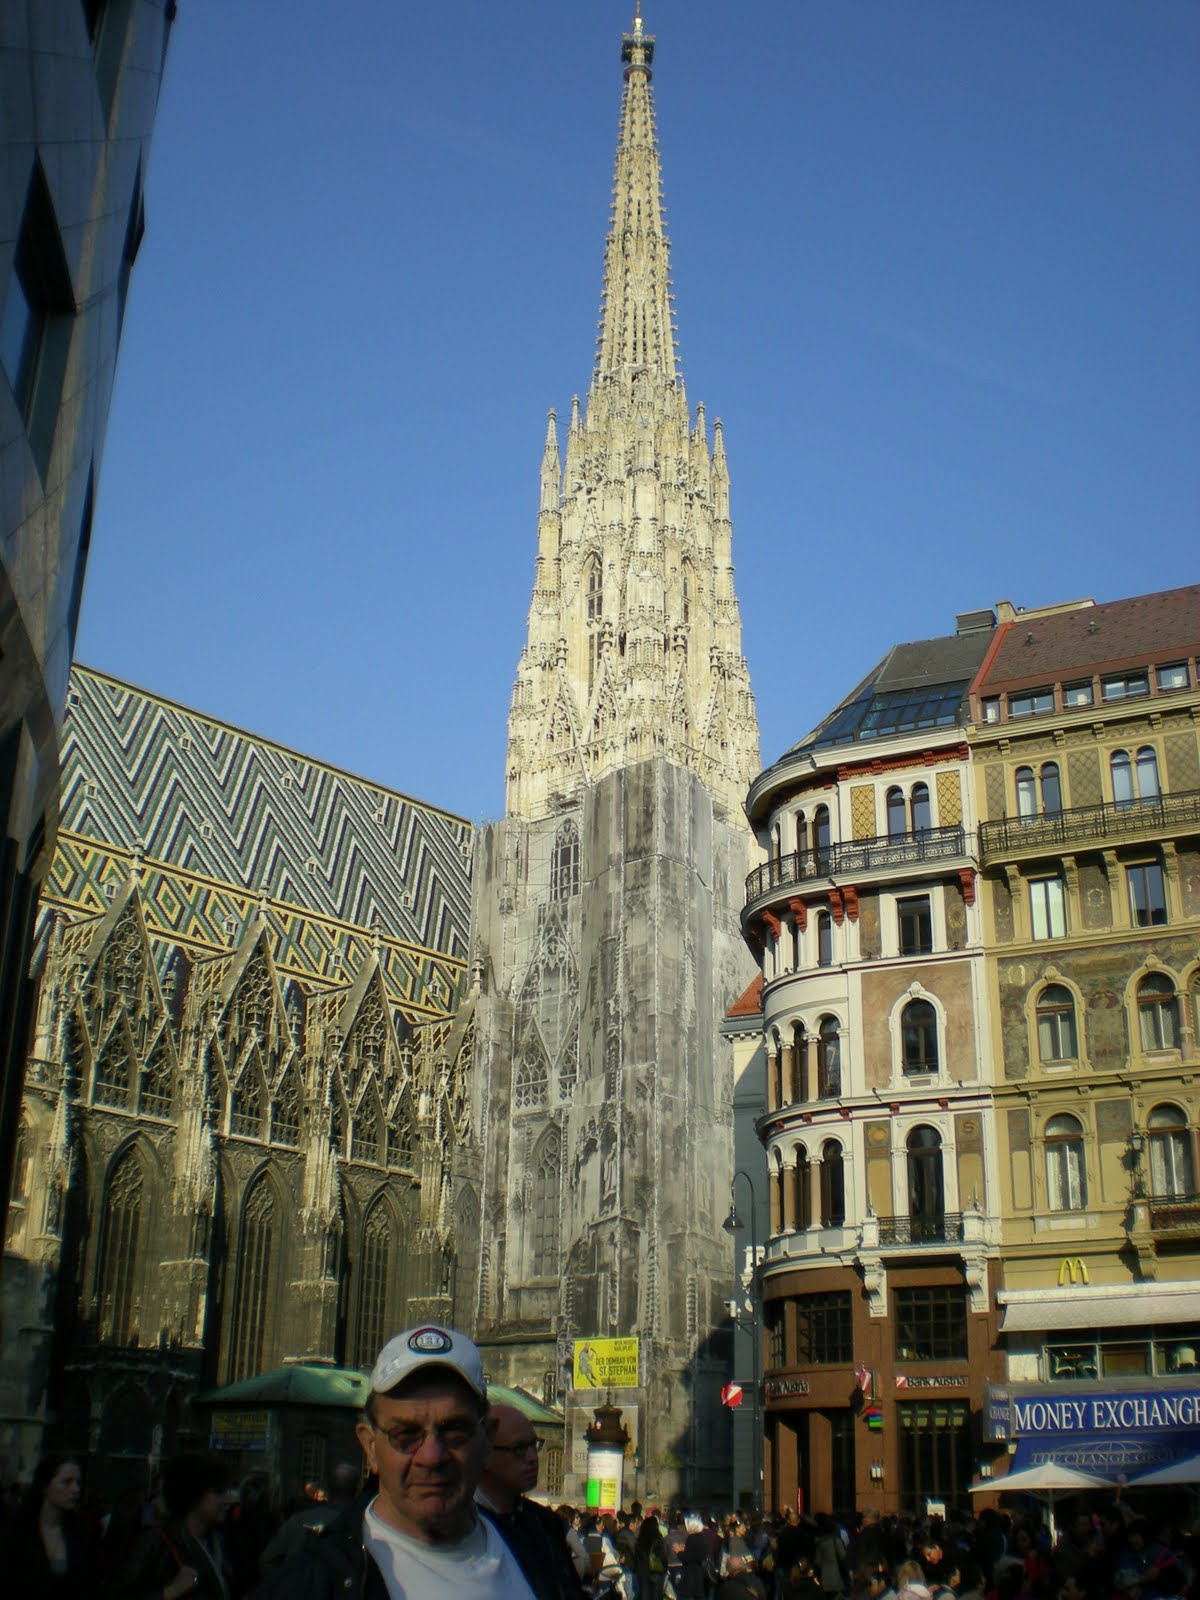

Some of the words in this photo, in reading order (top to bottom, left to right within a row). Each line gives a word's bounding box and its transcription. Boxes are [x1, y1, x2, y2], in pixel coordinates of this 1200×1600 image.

[595, 1358, 604, 1366] DER
[627, 1356, 636, 1364] VON
[599, 1367, 607, 1376] ST.
[609, 1365, 636, 1375] STEPHAN
[907, 1377, 930, 1387] Bank
[933, 1376, 966, 1386] Austria
[1014, 1402, 1087, 1430] MONEY
[1064, 1452, 1129, 1464] CHANGE
